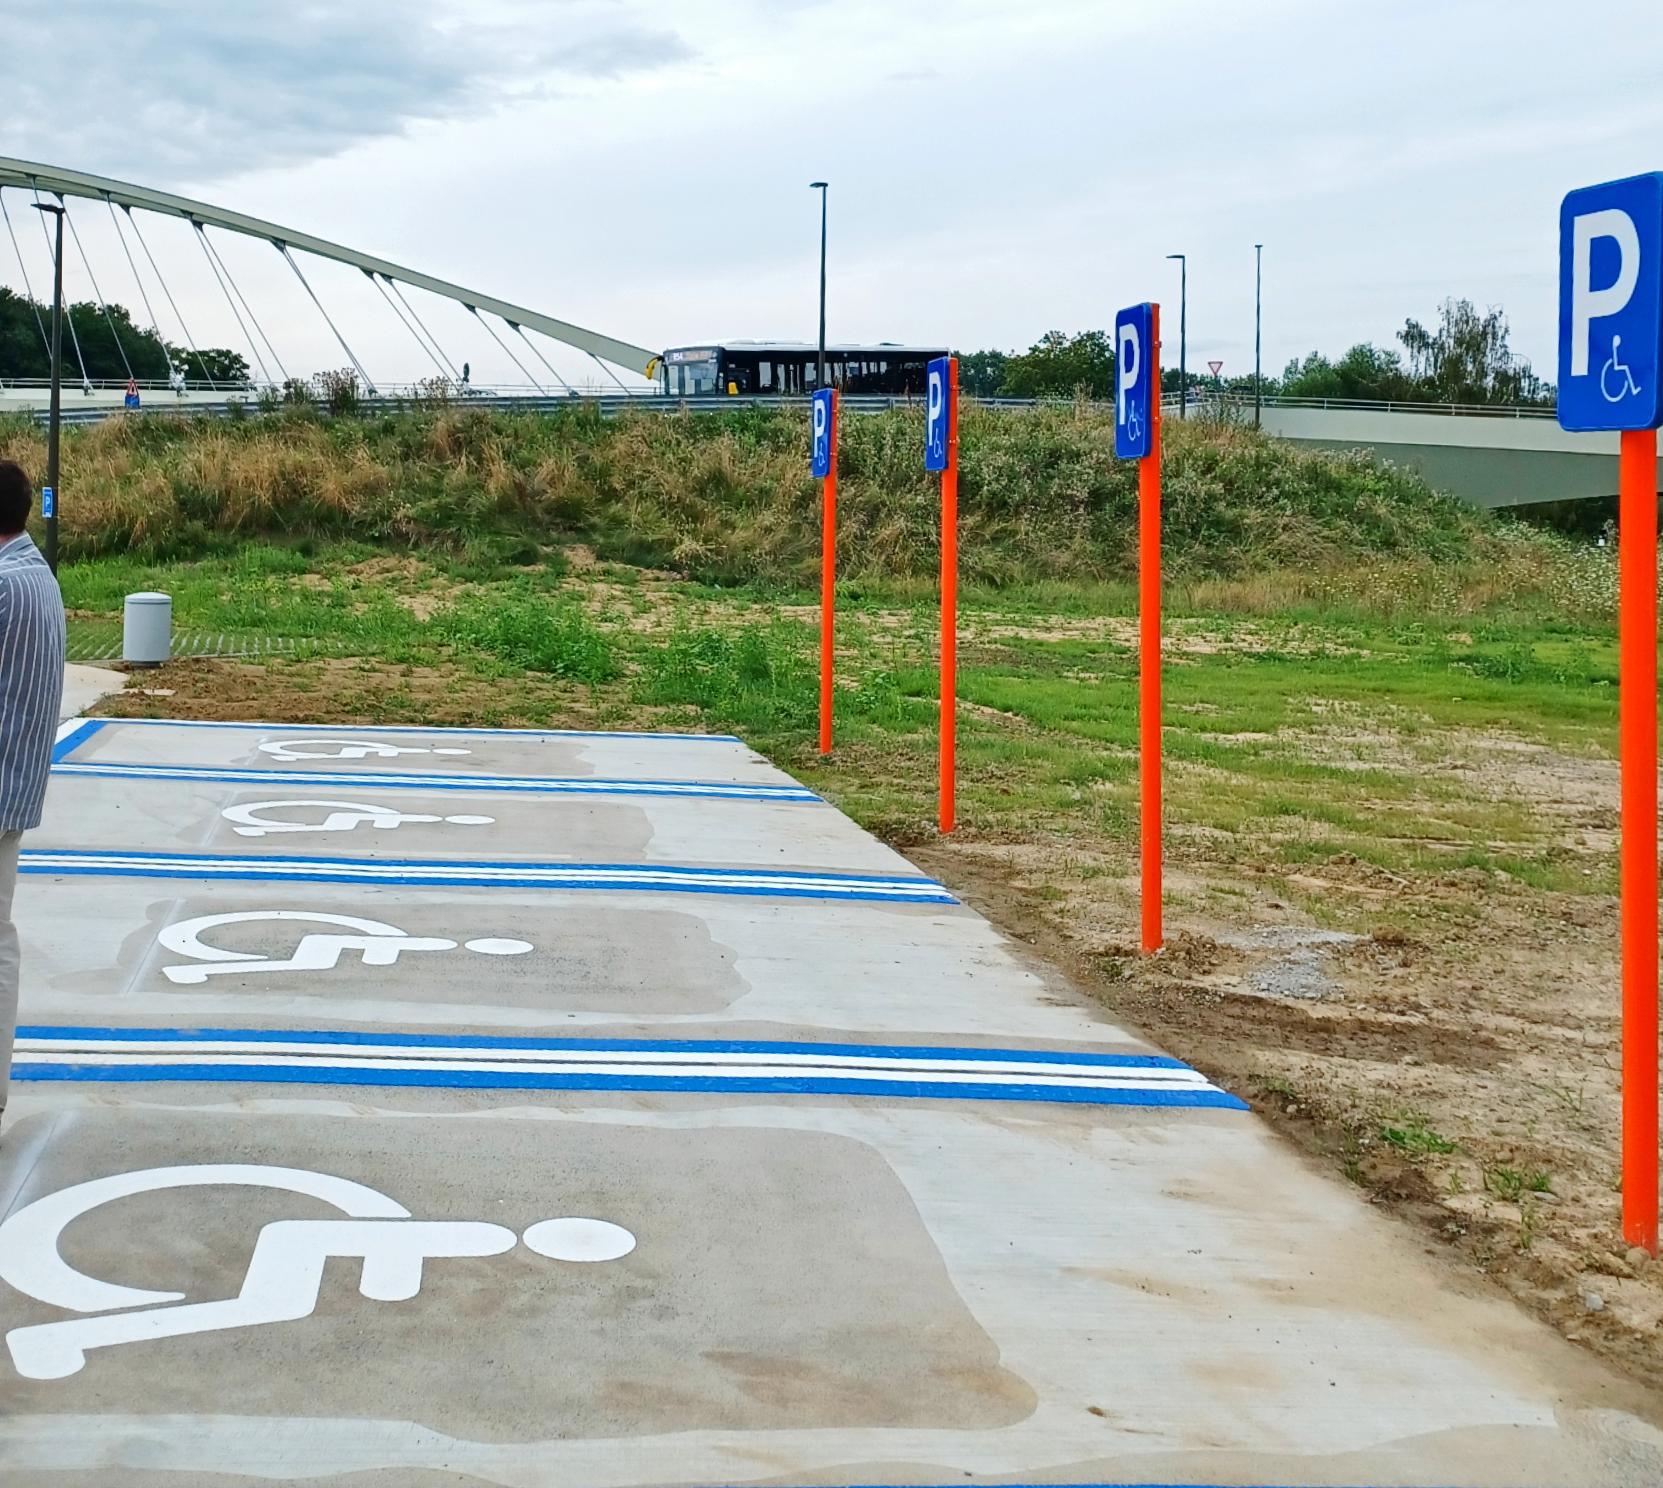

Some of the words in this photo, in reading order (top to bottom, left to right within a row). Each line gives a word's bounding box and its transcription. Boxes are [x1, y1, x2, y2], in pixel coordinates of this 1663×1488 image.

[1570, 208, 1641, 377] P
[928, 371, 942, 446] P
[1119, 323, 1140, 425] P
[814, 399, 826, 458] P
